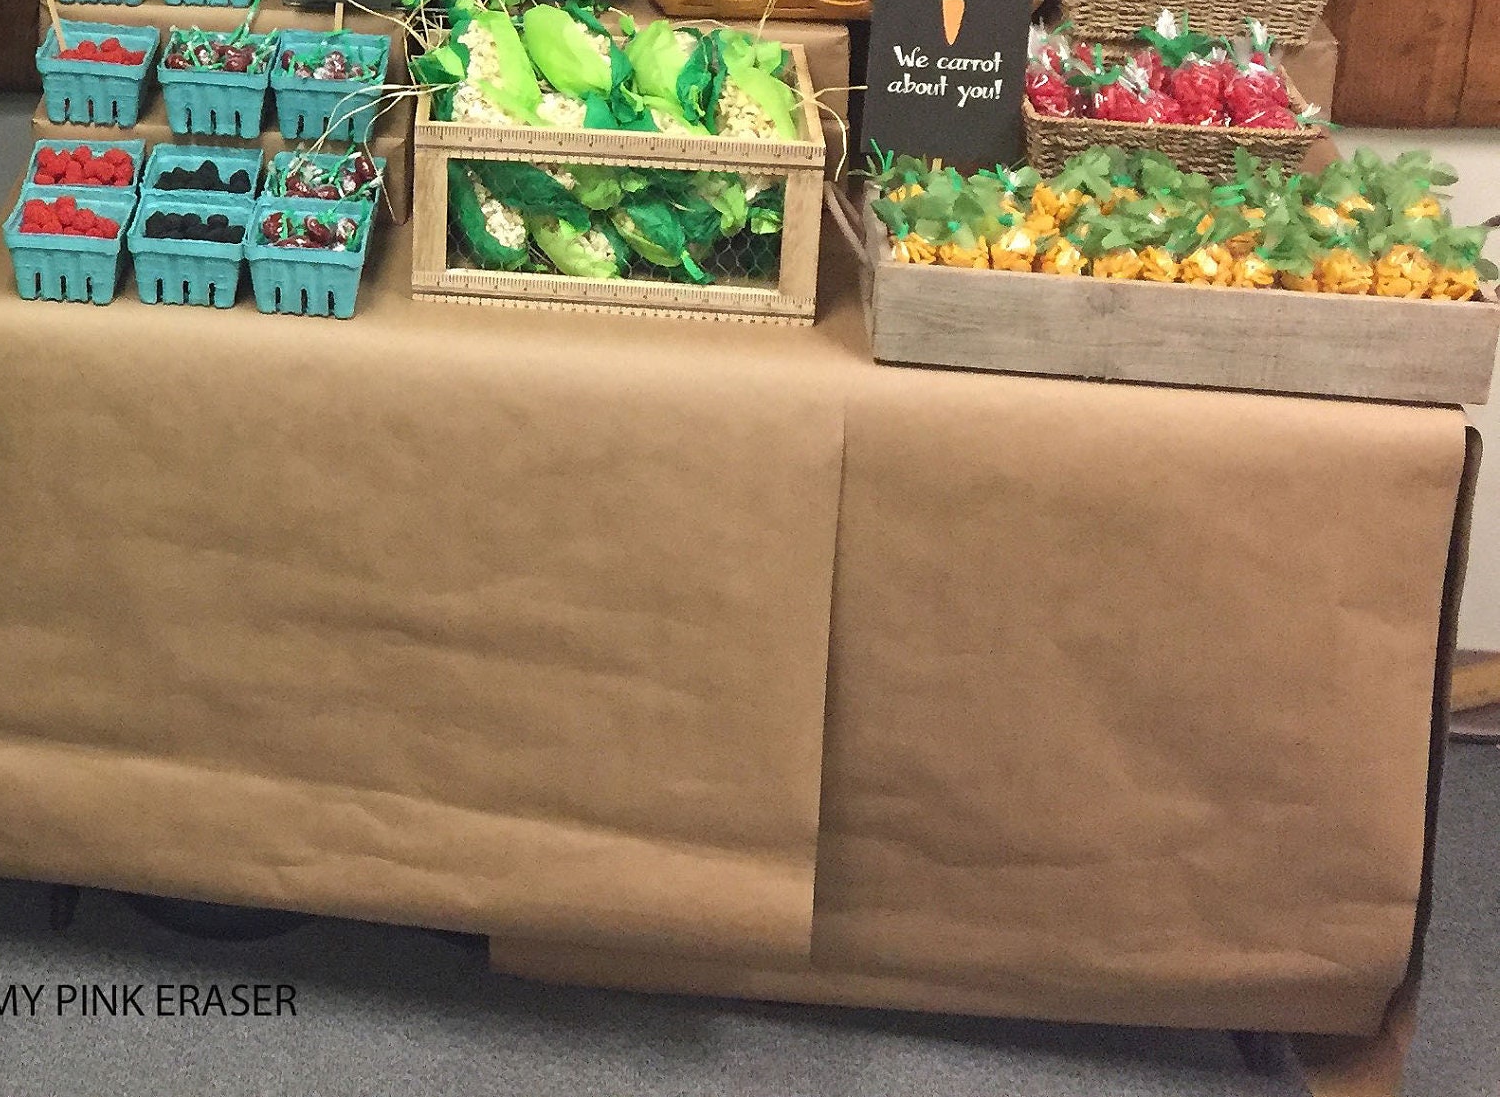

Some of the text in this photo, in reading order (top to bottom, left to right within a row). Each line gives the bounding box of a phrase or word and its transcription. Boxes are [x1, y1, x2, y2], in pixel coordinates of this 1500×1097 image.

[893, 45, 1003, 73] We carrot
[887, 73, 1003, 108] about you!
